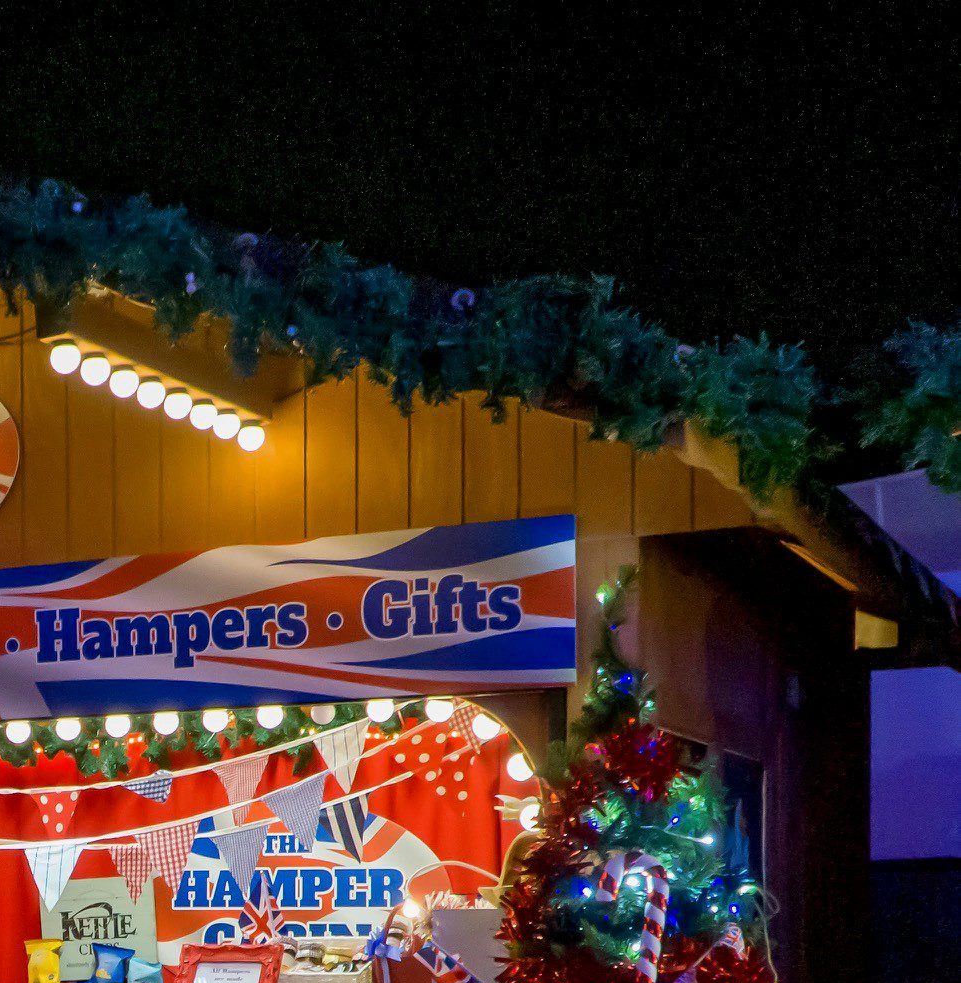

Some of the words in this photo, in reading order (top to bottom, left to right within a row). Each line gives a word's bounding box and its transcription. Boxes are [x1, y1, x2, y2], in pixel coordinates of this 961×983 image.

[35, 602, 309, 668] Hampers
[362, 574, 522, 639] Gifts
[172, 867, 405, 909] HAMPER
[59, 902, 137, 941] KETTLE
